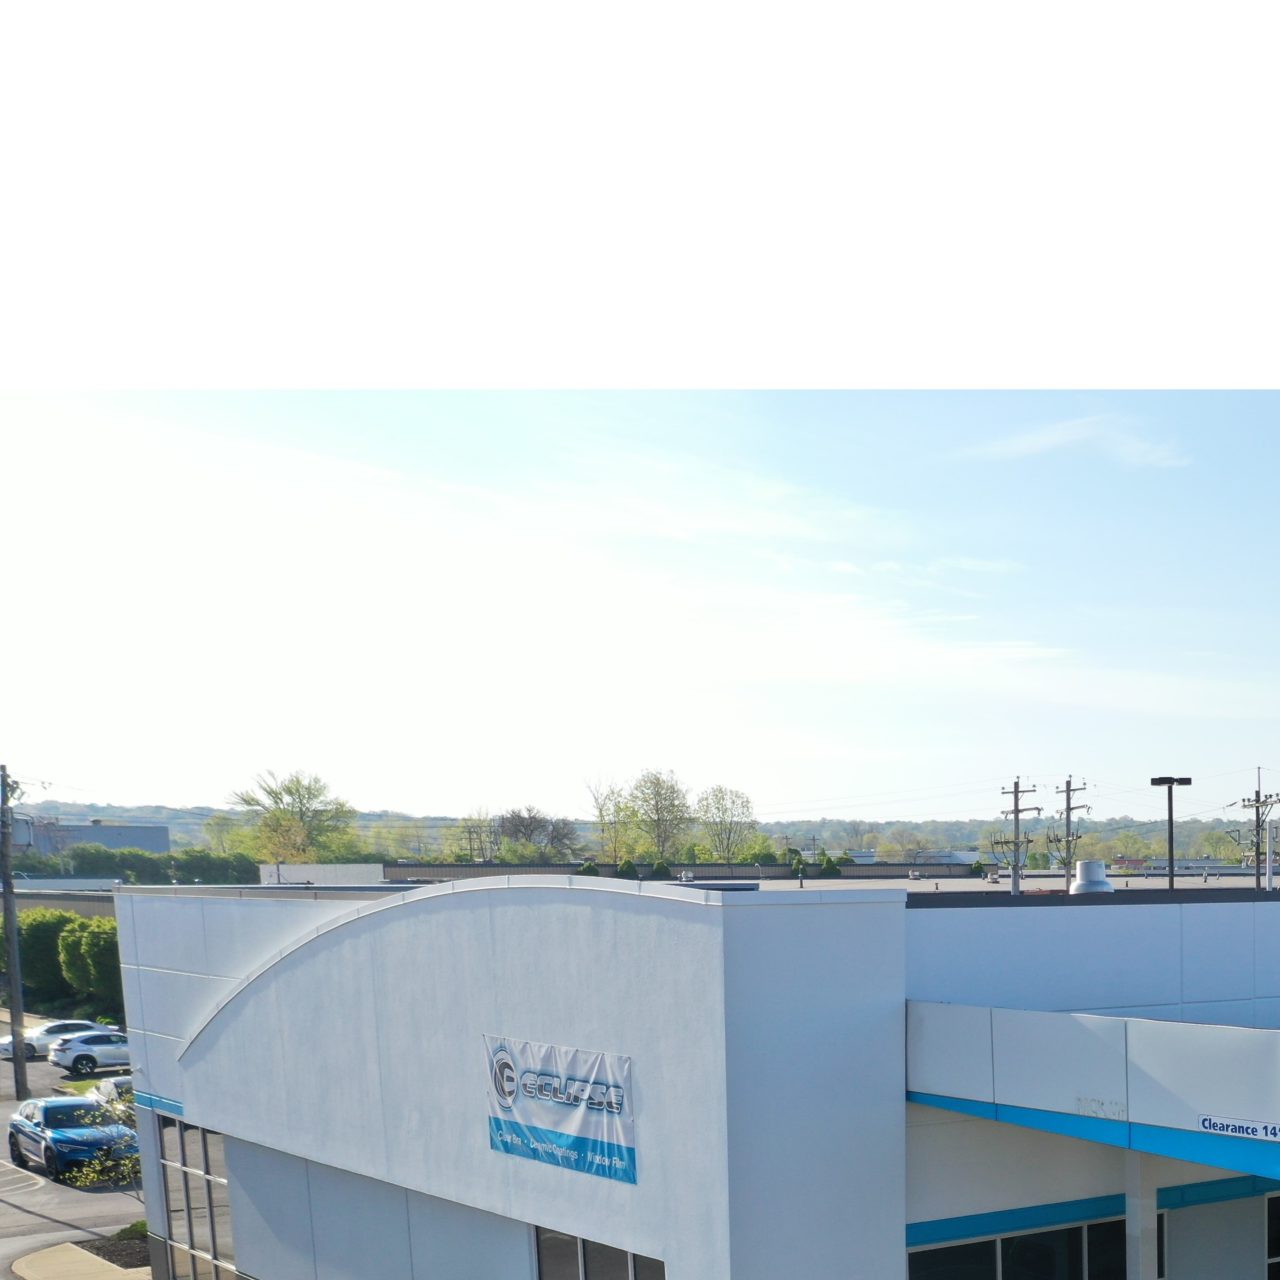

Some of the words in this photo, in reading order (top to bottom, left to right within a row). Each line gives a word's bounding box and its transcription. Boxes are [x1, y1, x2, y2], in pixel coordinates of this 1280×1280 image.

[520, 1071, 625, 1114] ECLIPSE
[1201, 1117, 1258, 1136] Clearance
[552, 1143, 579, 1161] Coatings
